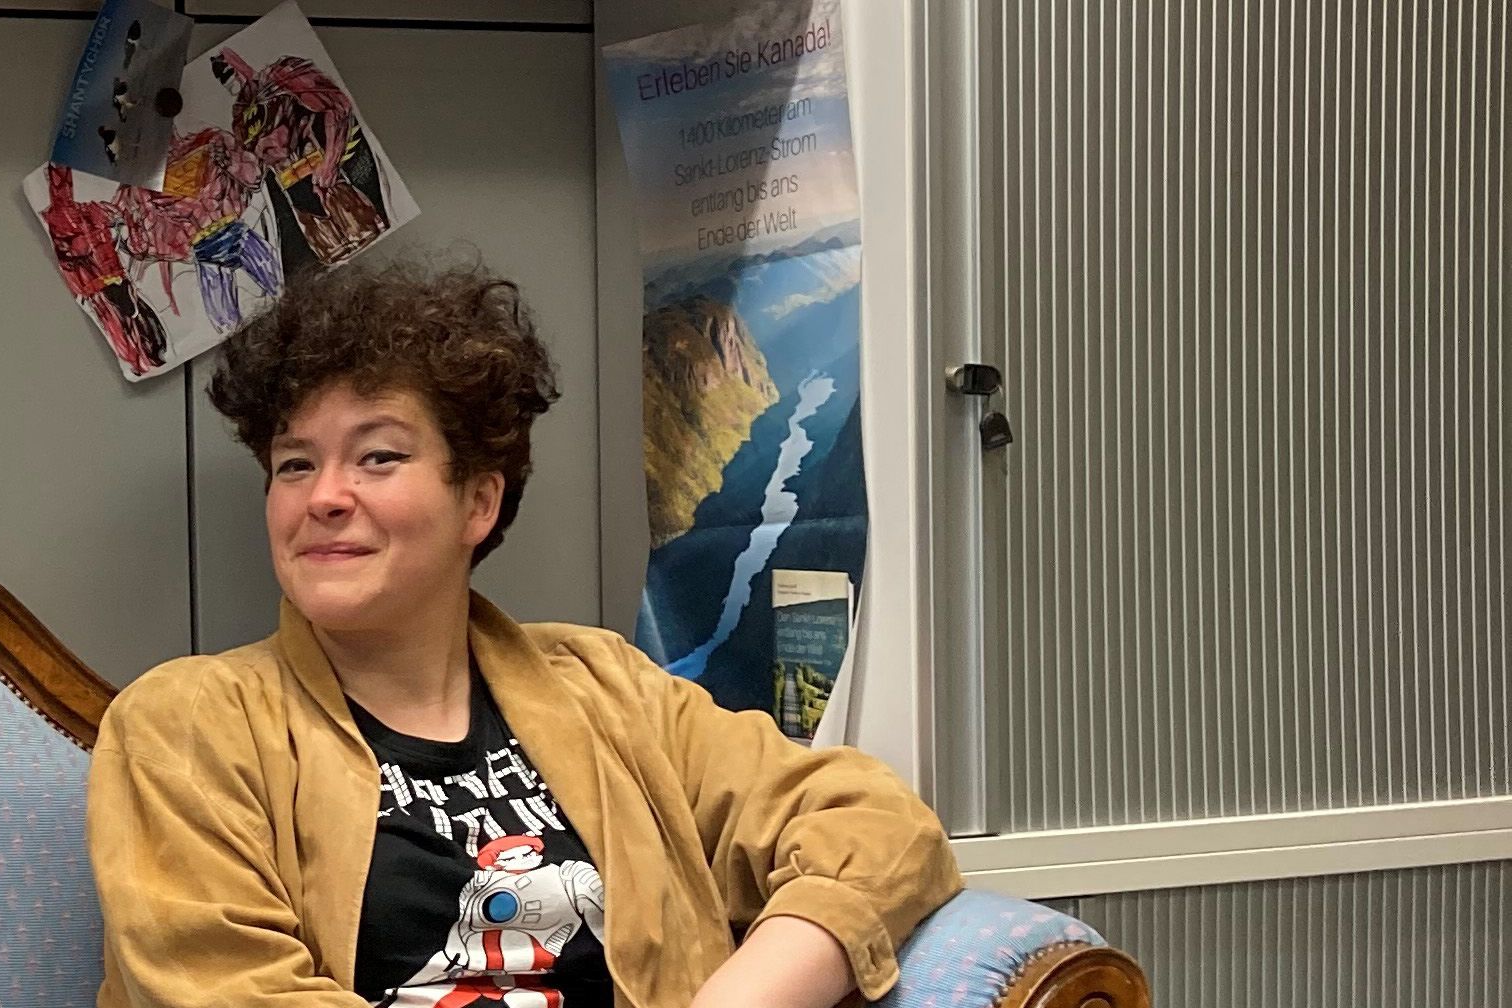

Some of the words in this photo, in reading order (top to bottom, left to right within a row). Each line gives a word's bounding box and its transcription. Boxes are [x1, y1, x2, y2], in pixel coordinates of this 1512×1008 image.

[62, 15, 112, 139] SHANTYCHOR
[638, 61, 721, 101] Erleben
[725, 48, 752, 79] Sie
[758, 18, 832, 68] Kanada!
[679, 120, 714, 151] 1400
[716, 103, 784, 138] Kilometer
[787, 97, 812, 121] am
[691, 187, 744, 217] entlang
[747, 178, 768, 203] bis
[771, 174, 799, 198] ans
[697, 222, 734, 251] Ende
[737, 215, 761, 241] der
[764, 205, 798, 235] Welt
